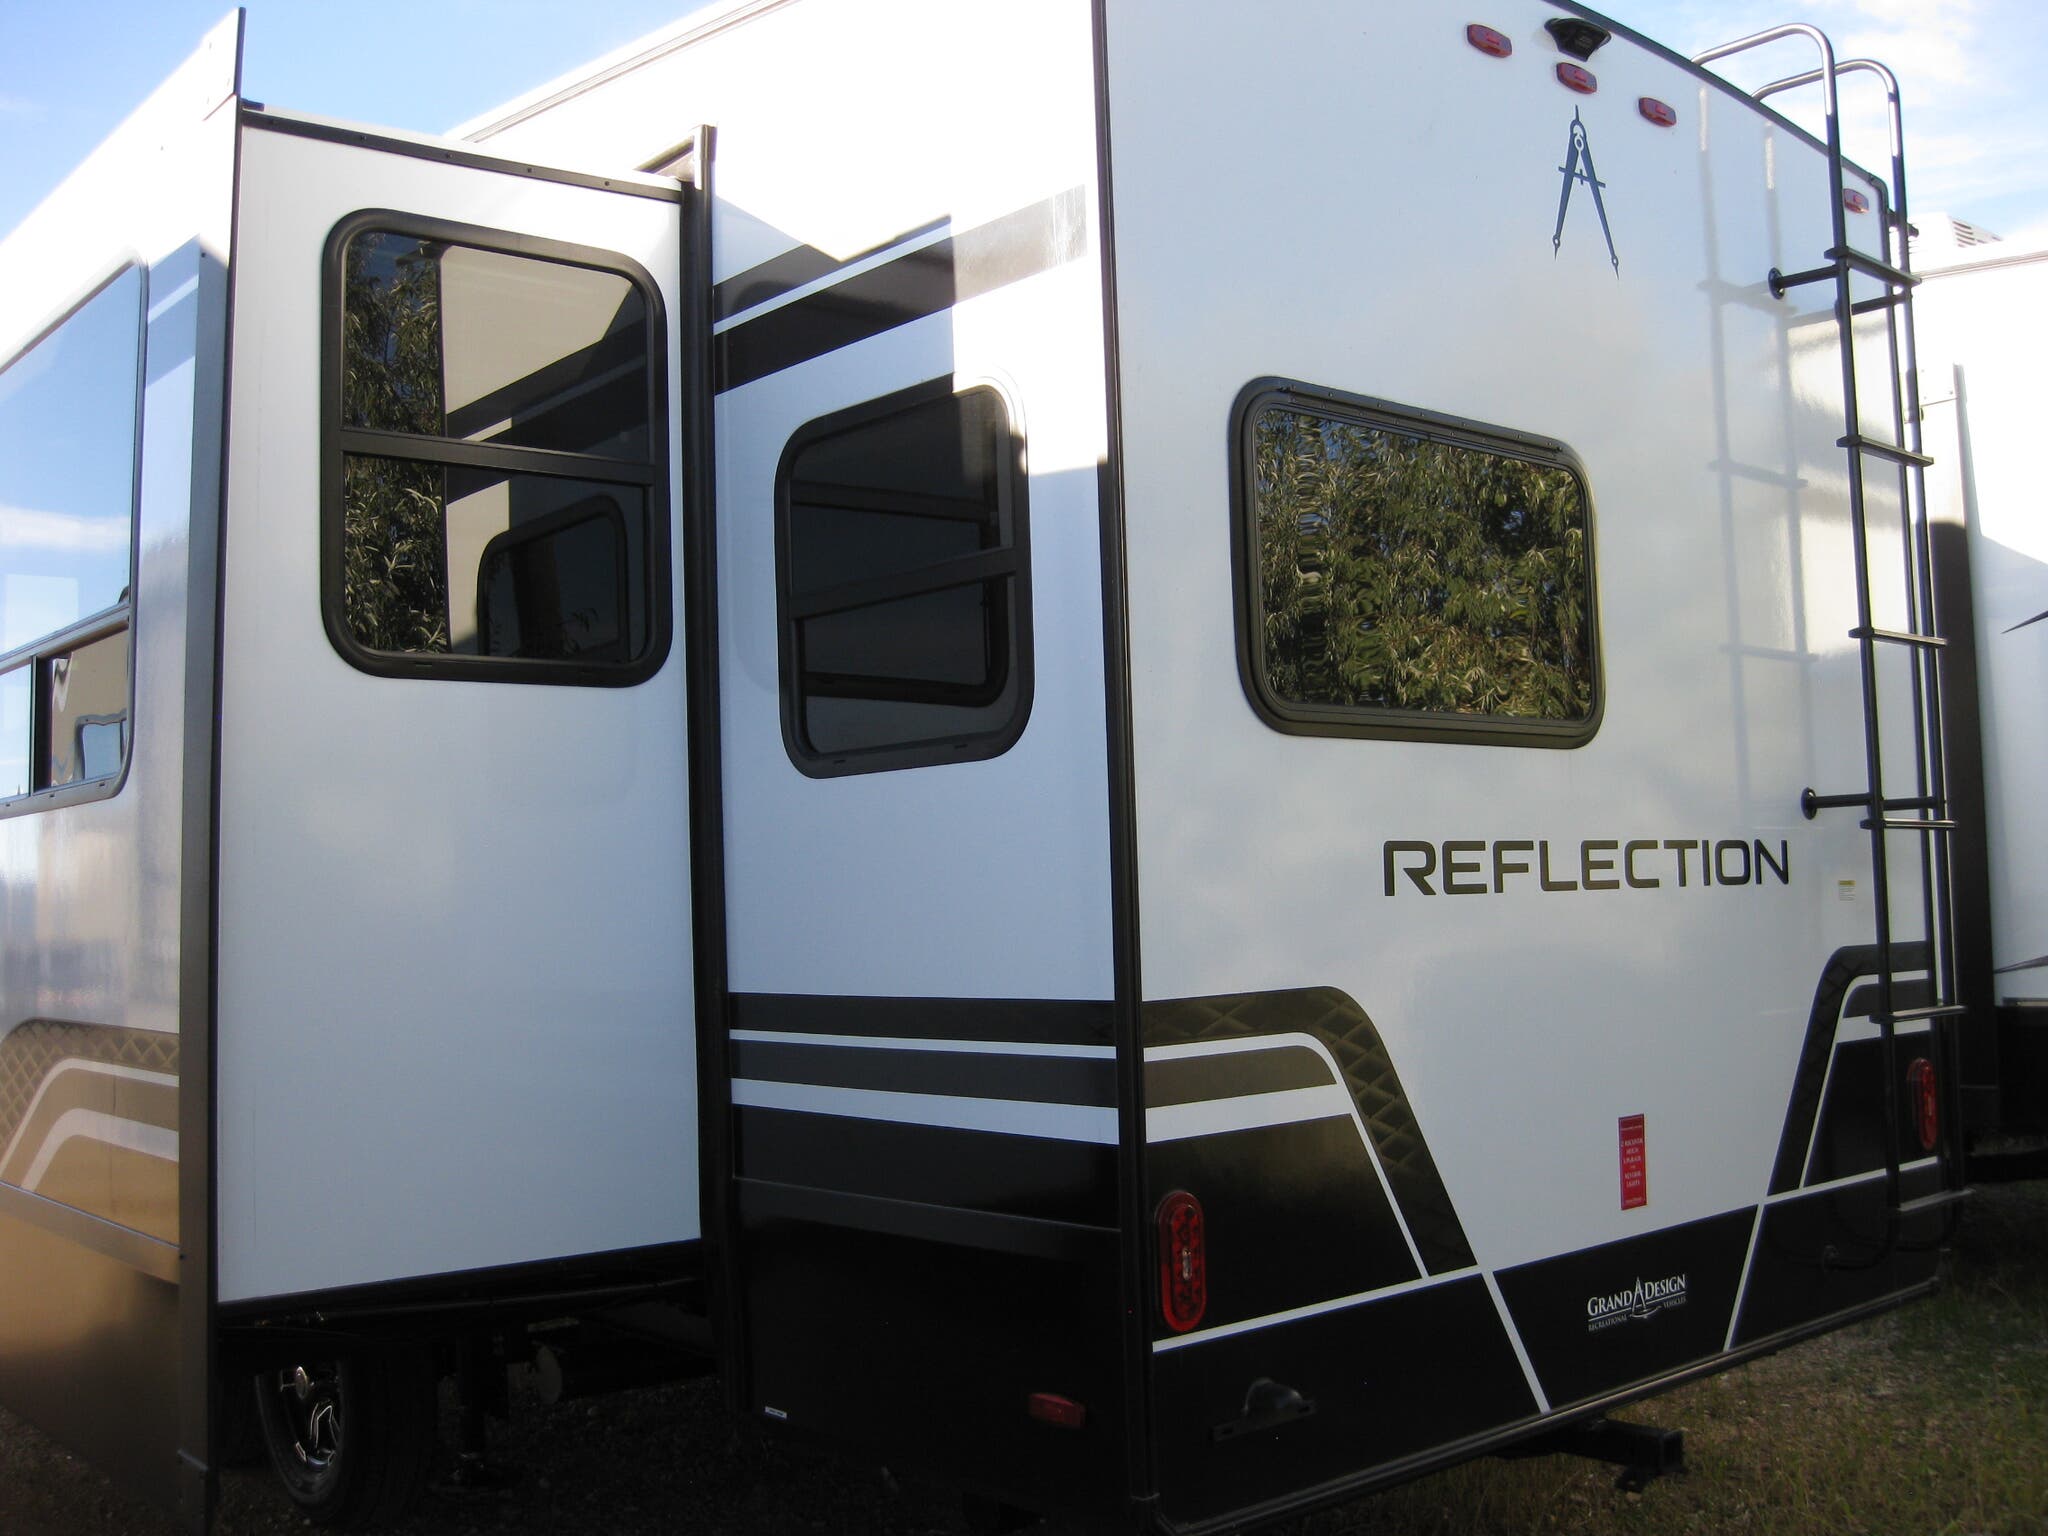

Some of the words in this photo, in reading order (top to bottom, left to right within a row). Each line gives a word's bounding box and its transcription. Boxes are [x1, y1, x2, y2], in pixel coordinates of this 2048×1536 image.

[1382, 839, 1790, 896] REFLECTION
[1587, 1290, 1633, 1317] GRAND
[1644, 1273, 1686, 1300] DESIGN
